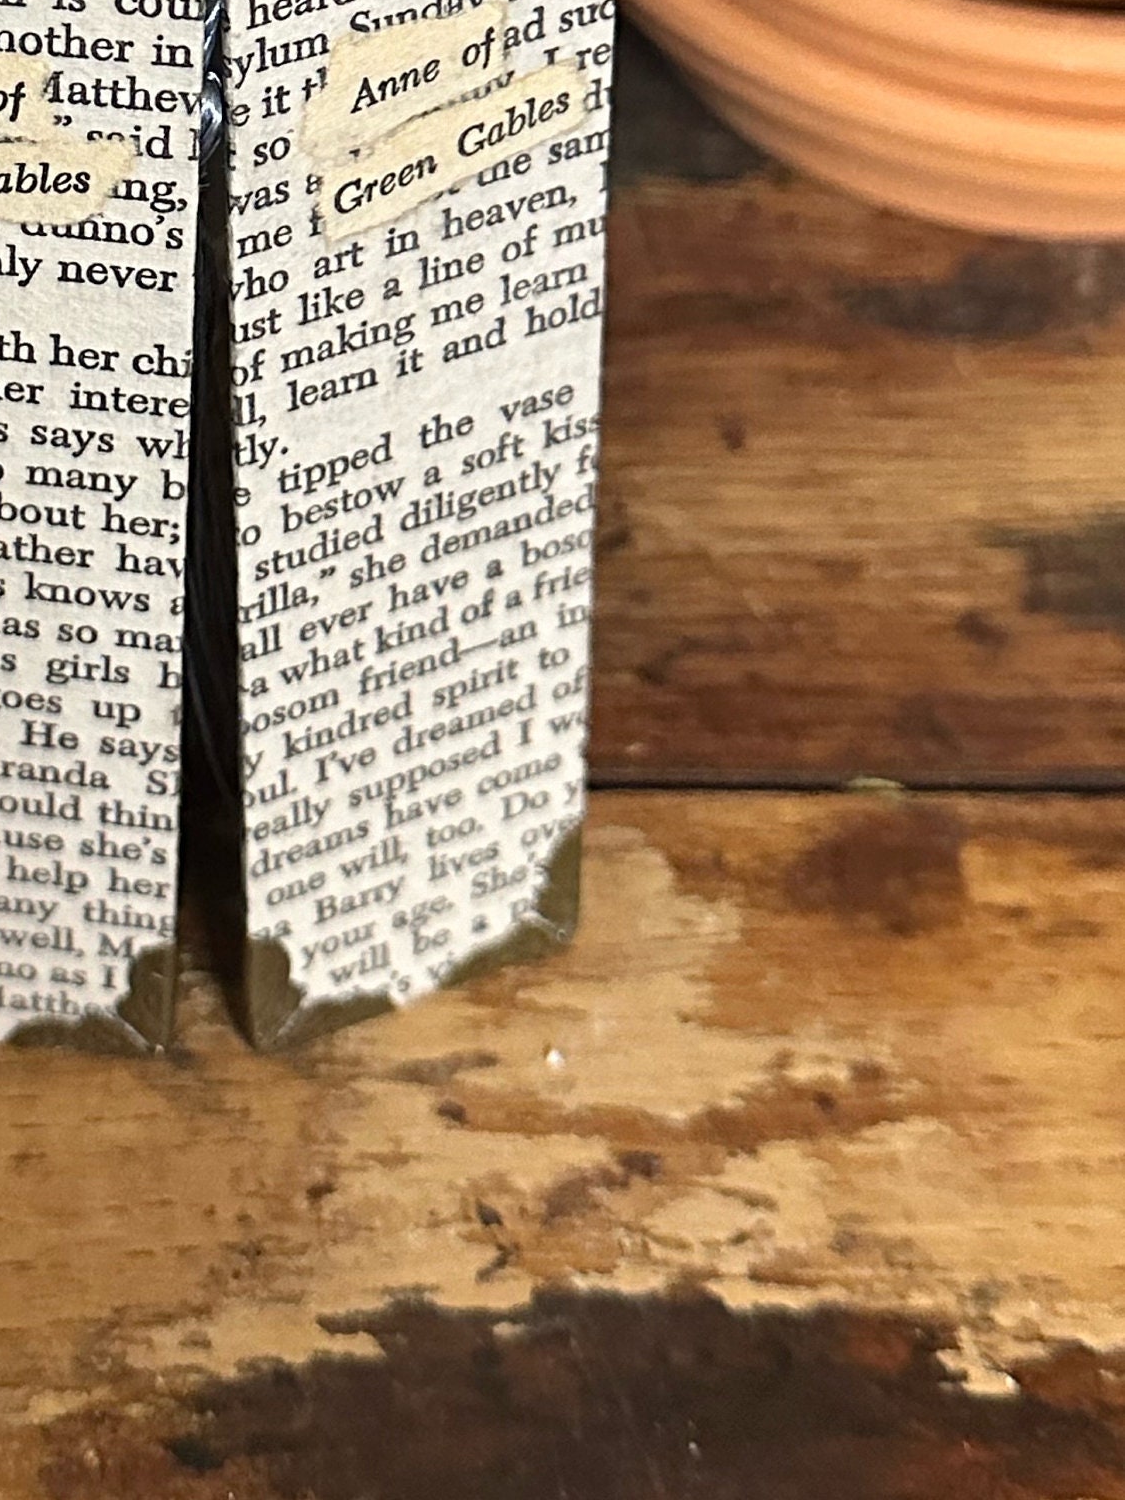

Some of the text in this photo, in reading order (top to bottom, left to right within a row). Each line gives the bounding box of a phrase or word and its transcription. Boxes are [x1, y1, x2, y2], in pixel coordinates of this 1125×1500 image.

[150, 33, 193, 68] in
[349, 26, 497, 115] Anne of
[333, 91, 570, 215] Green Gables
[313, 185, 578, 280] art in heaven,
[56, 260, 179, 293] never
[296, 252, 485, 327] like line
[48, 332, 120, 373] her
[280, 263, 588, 374] making me learn
[442, 286, 602, 364] and hold
[30, 424, 115, 459] says
[277, 384, 574, 496] tipped vase
[24, 465, 139, 503] many
[279, 431, 525, 534] bestow soft
[100, 501, 182, 546] her;
[254, 460, 561, 583] studied diligently
[23, 570, 150, 614] knows
[299, 570, 469, 643] ever have
[45, 654, 130, 686] girls
[279, 587, 495, 685] what kind of
[19, 719, 79, 751] He
[283, 660, 518, 761] kindred spirit
[393, 684, 536, 756] dreamed
[348, 729, 501, 810] supposed
[6, 855, 89, 896] help
